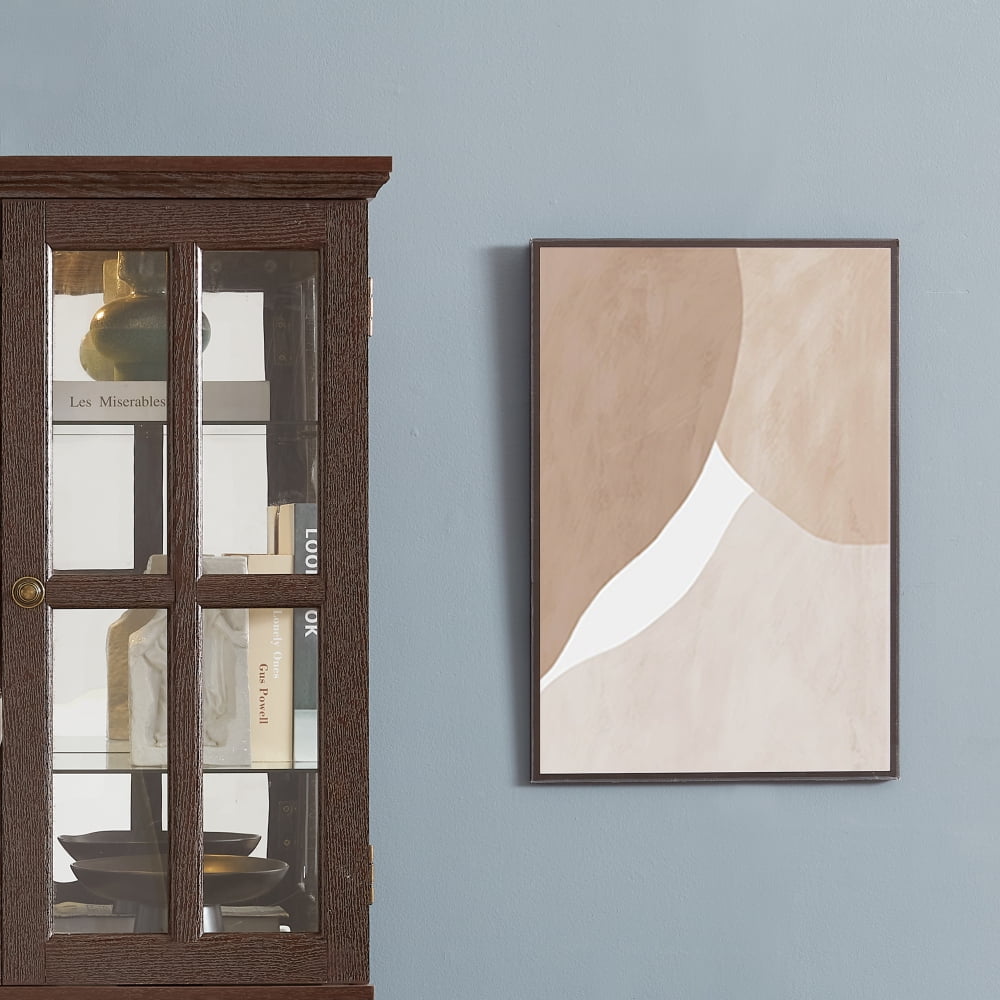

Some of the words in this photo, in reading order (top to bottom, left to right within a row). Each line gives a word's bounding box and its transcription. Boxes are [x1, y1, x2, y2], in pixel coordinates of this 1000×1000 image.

[70, 396, 92, 408] Les
[100, 395, 166, 408] Miserables
[270, 609, 283, 647] Lonely
[258, 663, 269, 684] Gus
[272, 651, 283, 679] Ones
[258, 688, 269, 724] Powell
